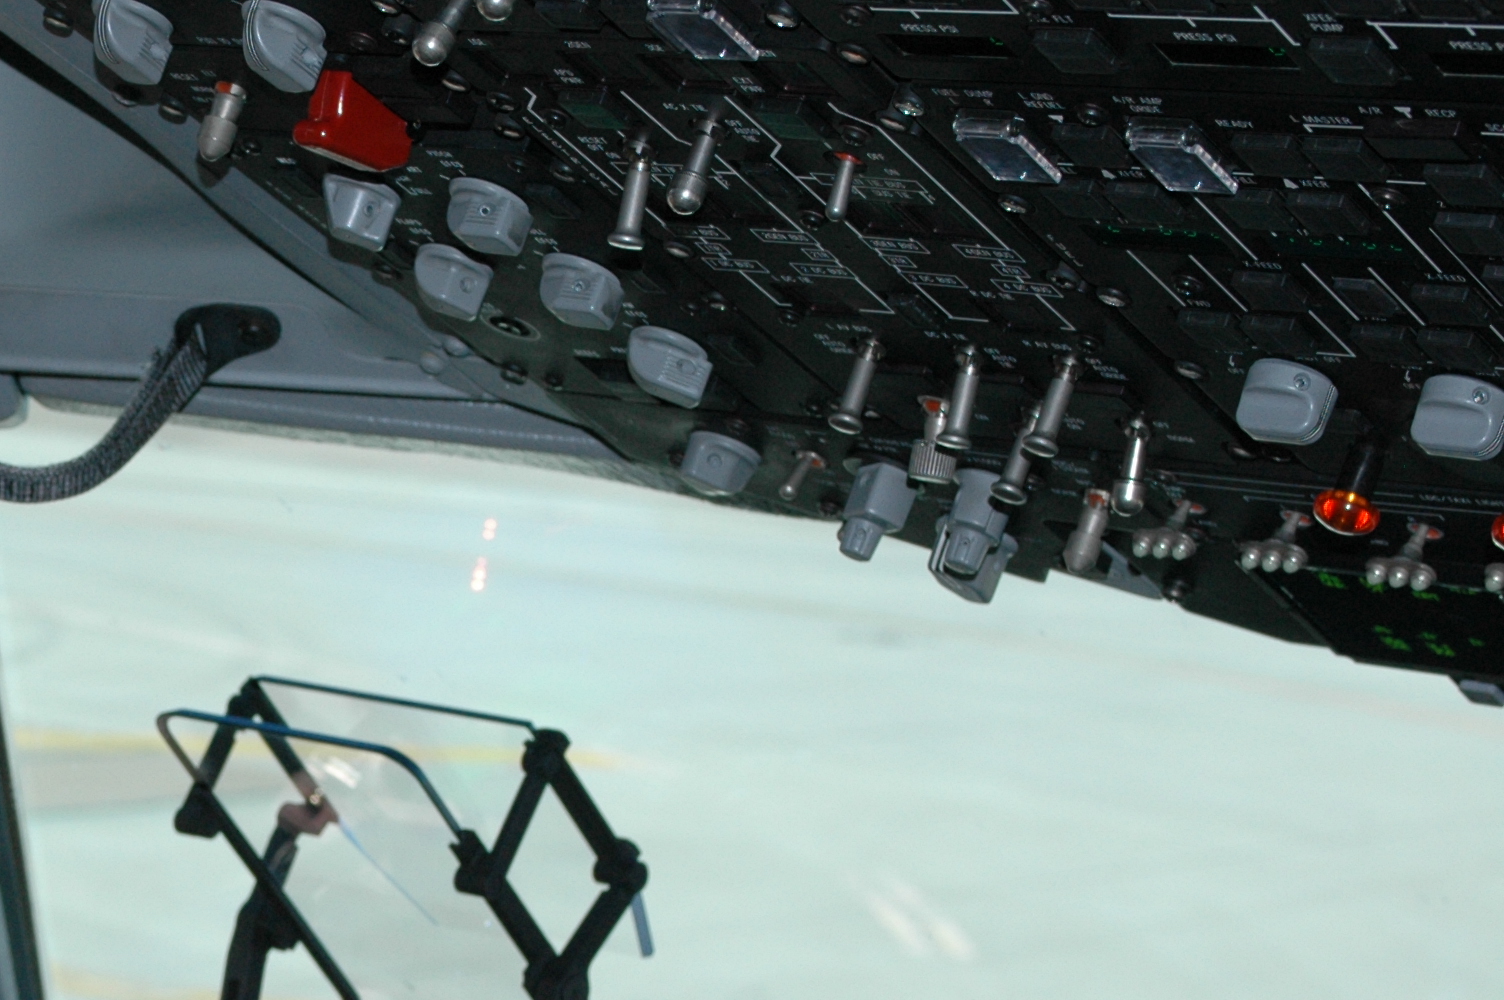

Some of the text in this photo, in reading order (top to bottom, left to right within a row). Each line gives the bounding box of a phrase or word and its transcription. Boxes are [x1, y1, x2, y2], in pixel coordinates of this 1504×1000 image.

[1303, 13, 1337, 23] XFER
[900, 23, 959, 33] PRESS PSI
[1309, 22, 1344, 32] PUMP
[1173, 32, 1238, 43] PRESS PSI
[1448, 40, 1493, 51] PRESS
[1357, 105, 1457, 118] A/R RECP
[1214, 119, 1254, 129] READY
[1302, 114, 1353, 125] MASTER
[522, 116, 619, 196] ELECTRICAL
[1424, 272, 1467, 283] X-FEED
